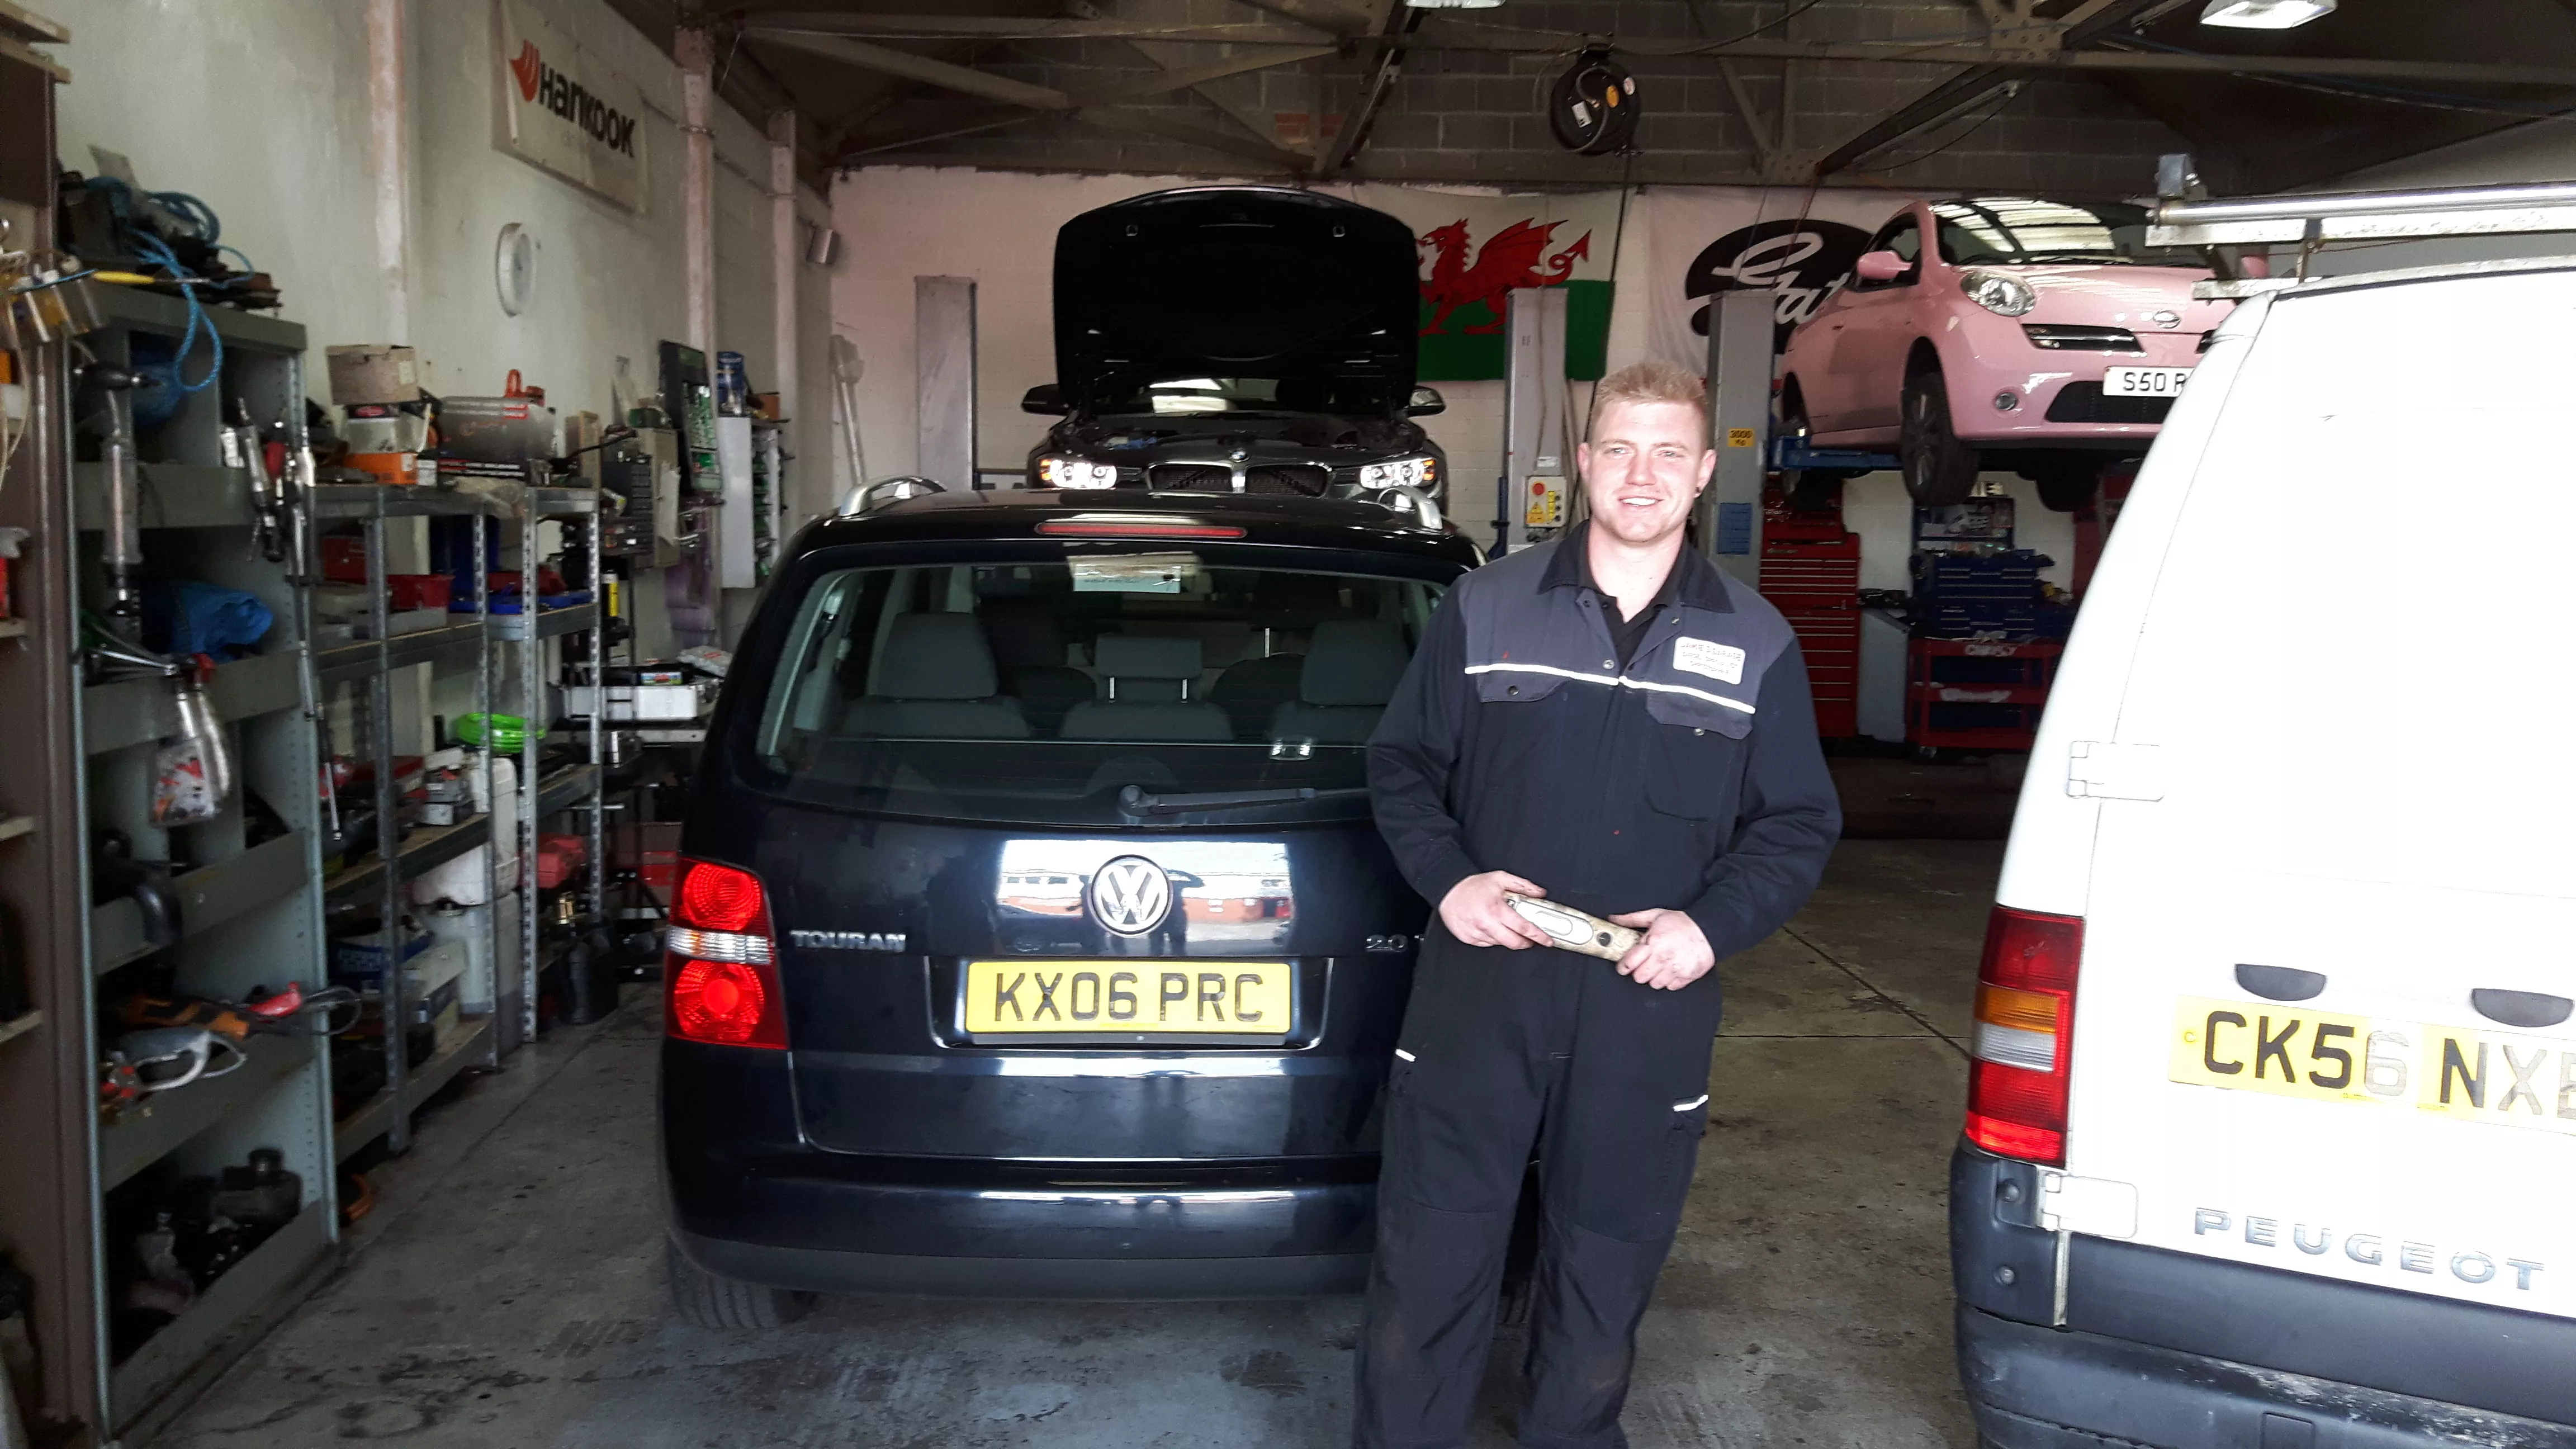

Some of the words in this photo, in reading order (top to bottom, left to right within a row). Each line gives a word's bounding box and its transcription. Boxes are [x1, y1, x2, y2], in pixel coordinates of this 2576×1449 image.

[2123, 372, 2167, 392] S50
[790, 930, 906, 952] TOURAN
[995, 972, 1138, 1022] KX06
[1159, 973, 1263, 1022] PRC
[2204, 1010, 2409, 1097] CK56
[2194, 1207, 2545, 1291] PEUGEOT
